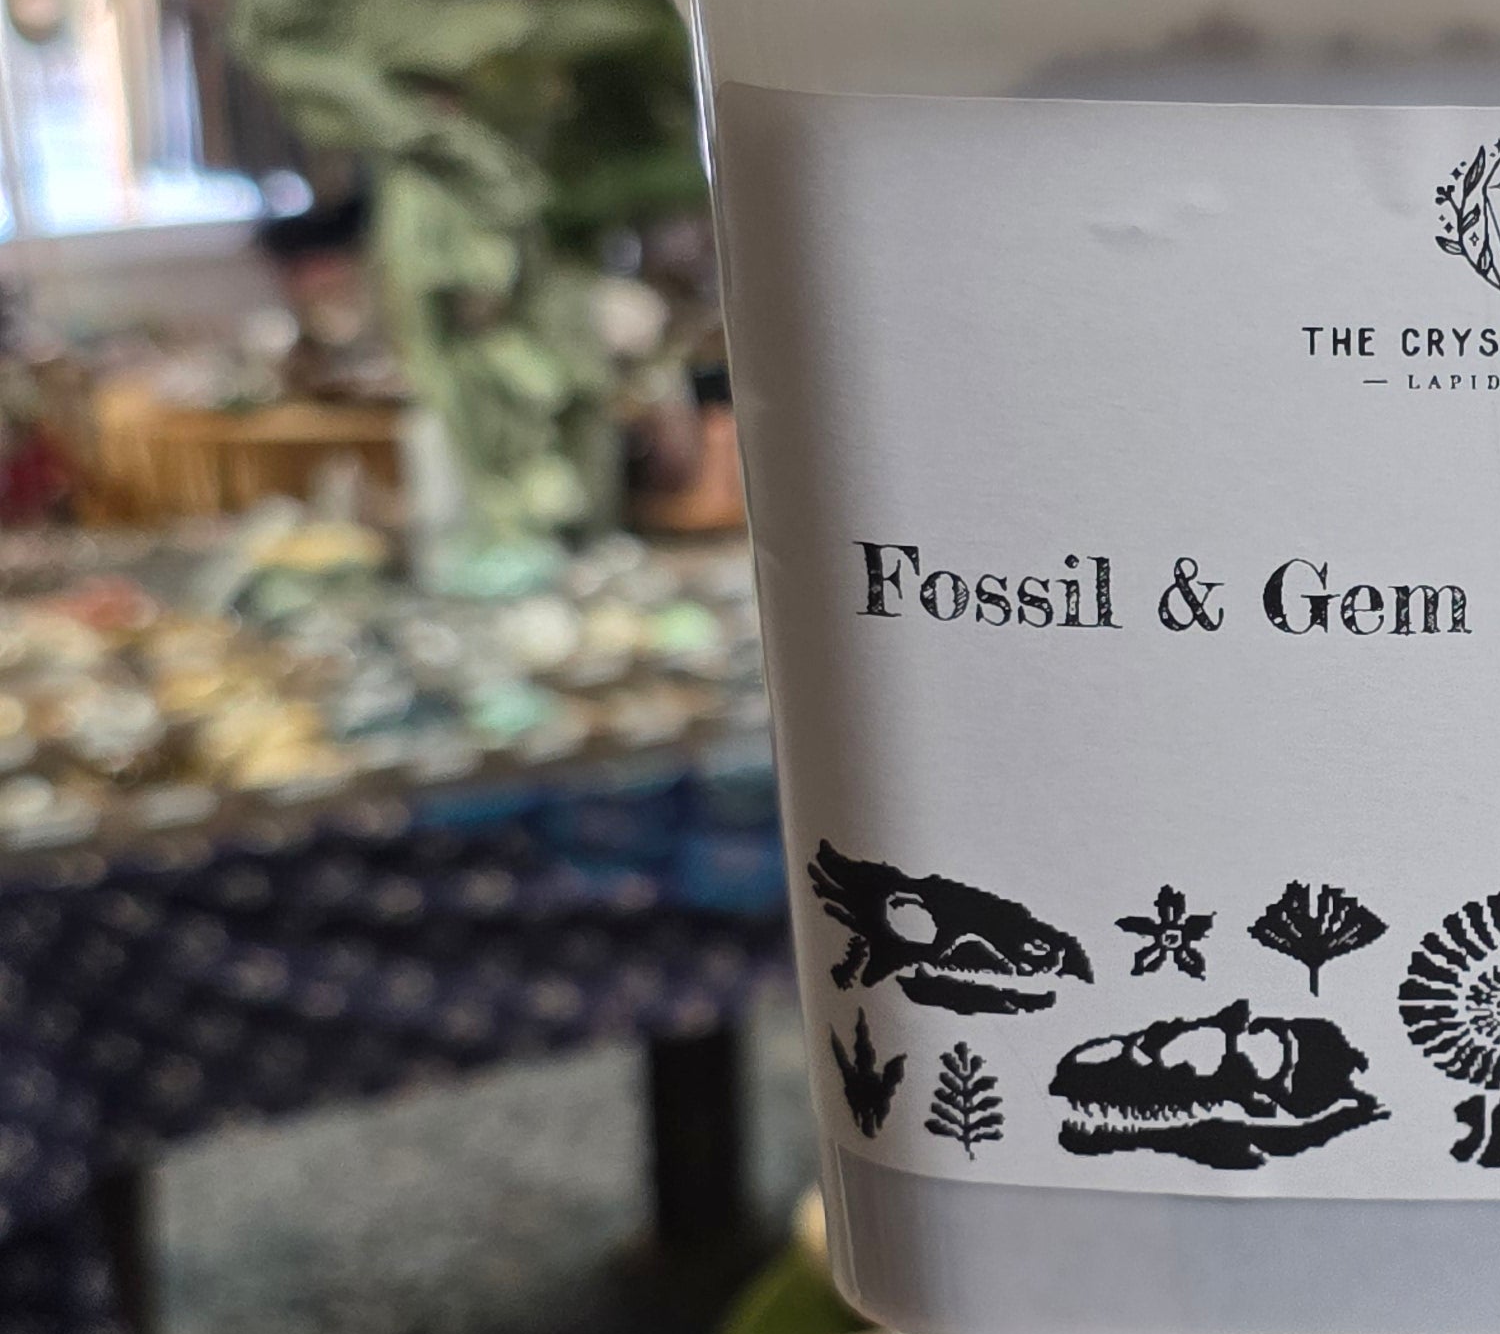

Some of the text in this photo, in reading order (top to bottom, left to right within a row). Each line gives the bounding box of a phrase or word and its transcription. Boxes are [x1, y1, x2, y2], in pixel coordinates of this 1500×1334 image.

[1301, 326, 1376, 357] THE
[852, 540, 1124, 630] Fossil
[1156, 556, 1226, 634] &
[1260, 556, 1474, 637] Gem
